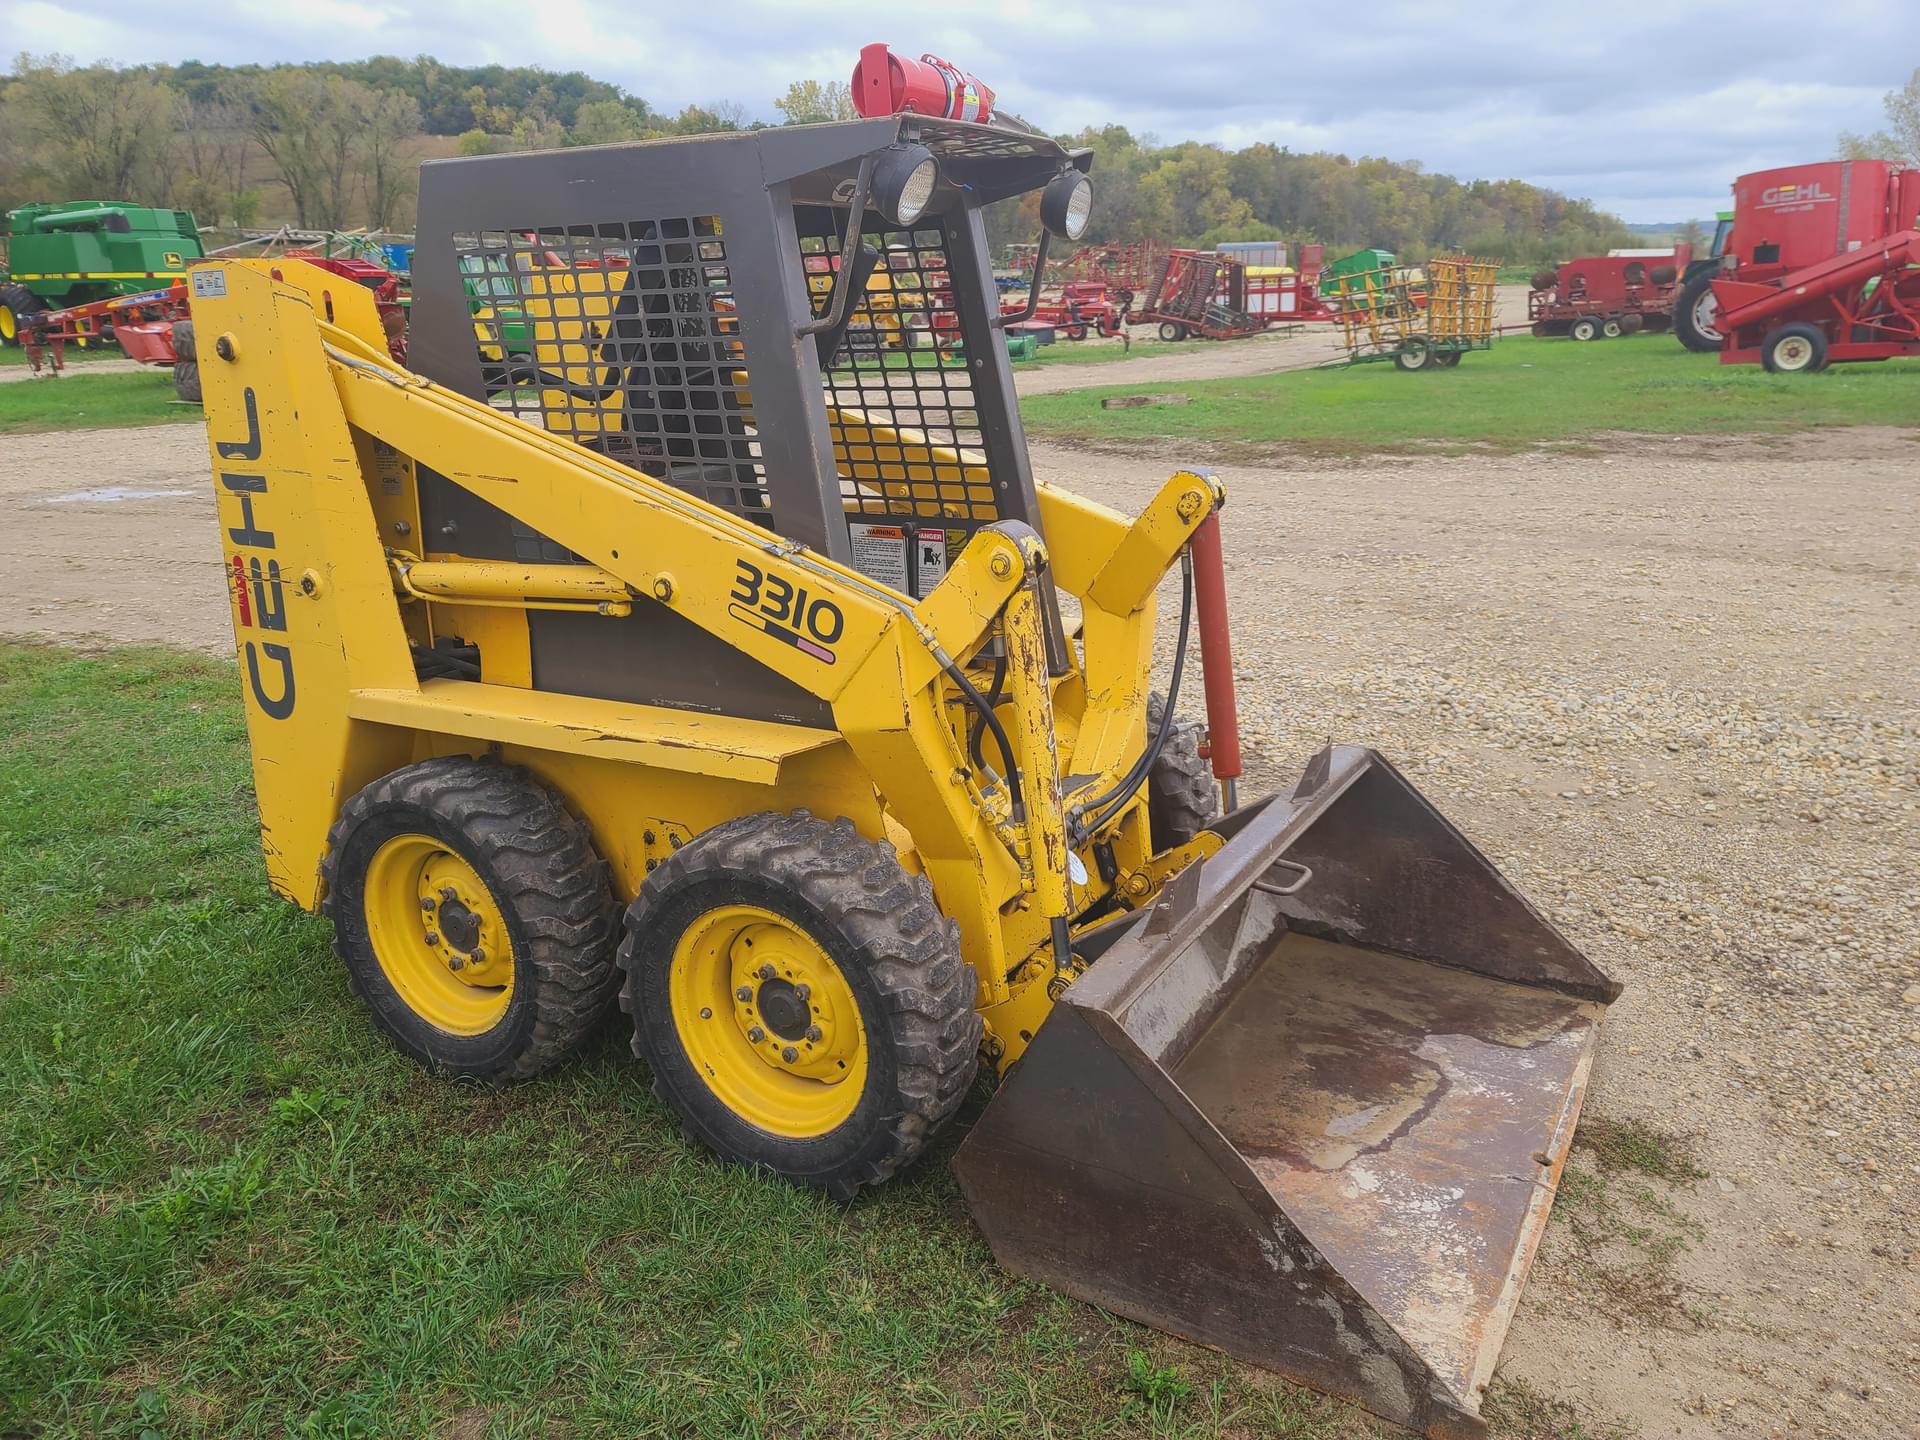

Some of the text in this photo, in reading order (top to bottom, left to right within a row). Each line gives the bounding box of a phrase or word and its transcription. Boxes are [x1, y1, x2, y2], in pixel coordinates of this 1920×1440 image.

[1762, 183, 1831, 204] GEHL
[866, 528, 896, 537] WARNING
[918, 532, 942, 540] ANGER
[216, 387, 295, 720] GEHL
[730, 558, 844, 644] 3310
